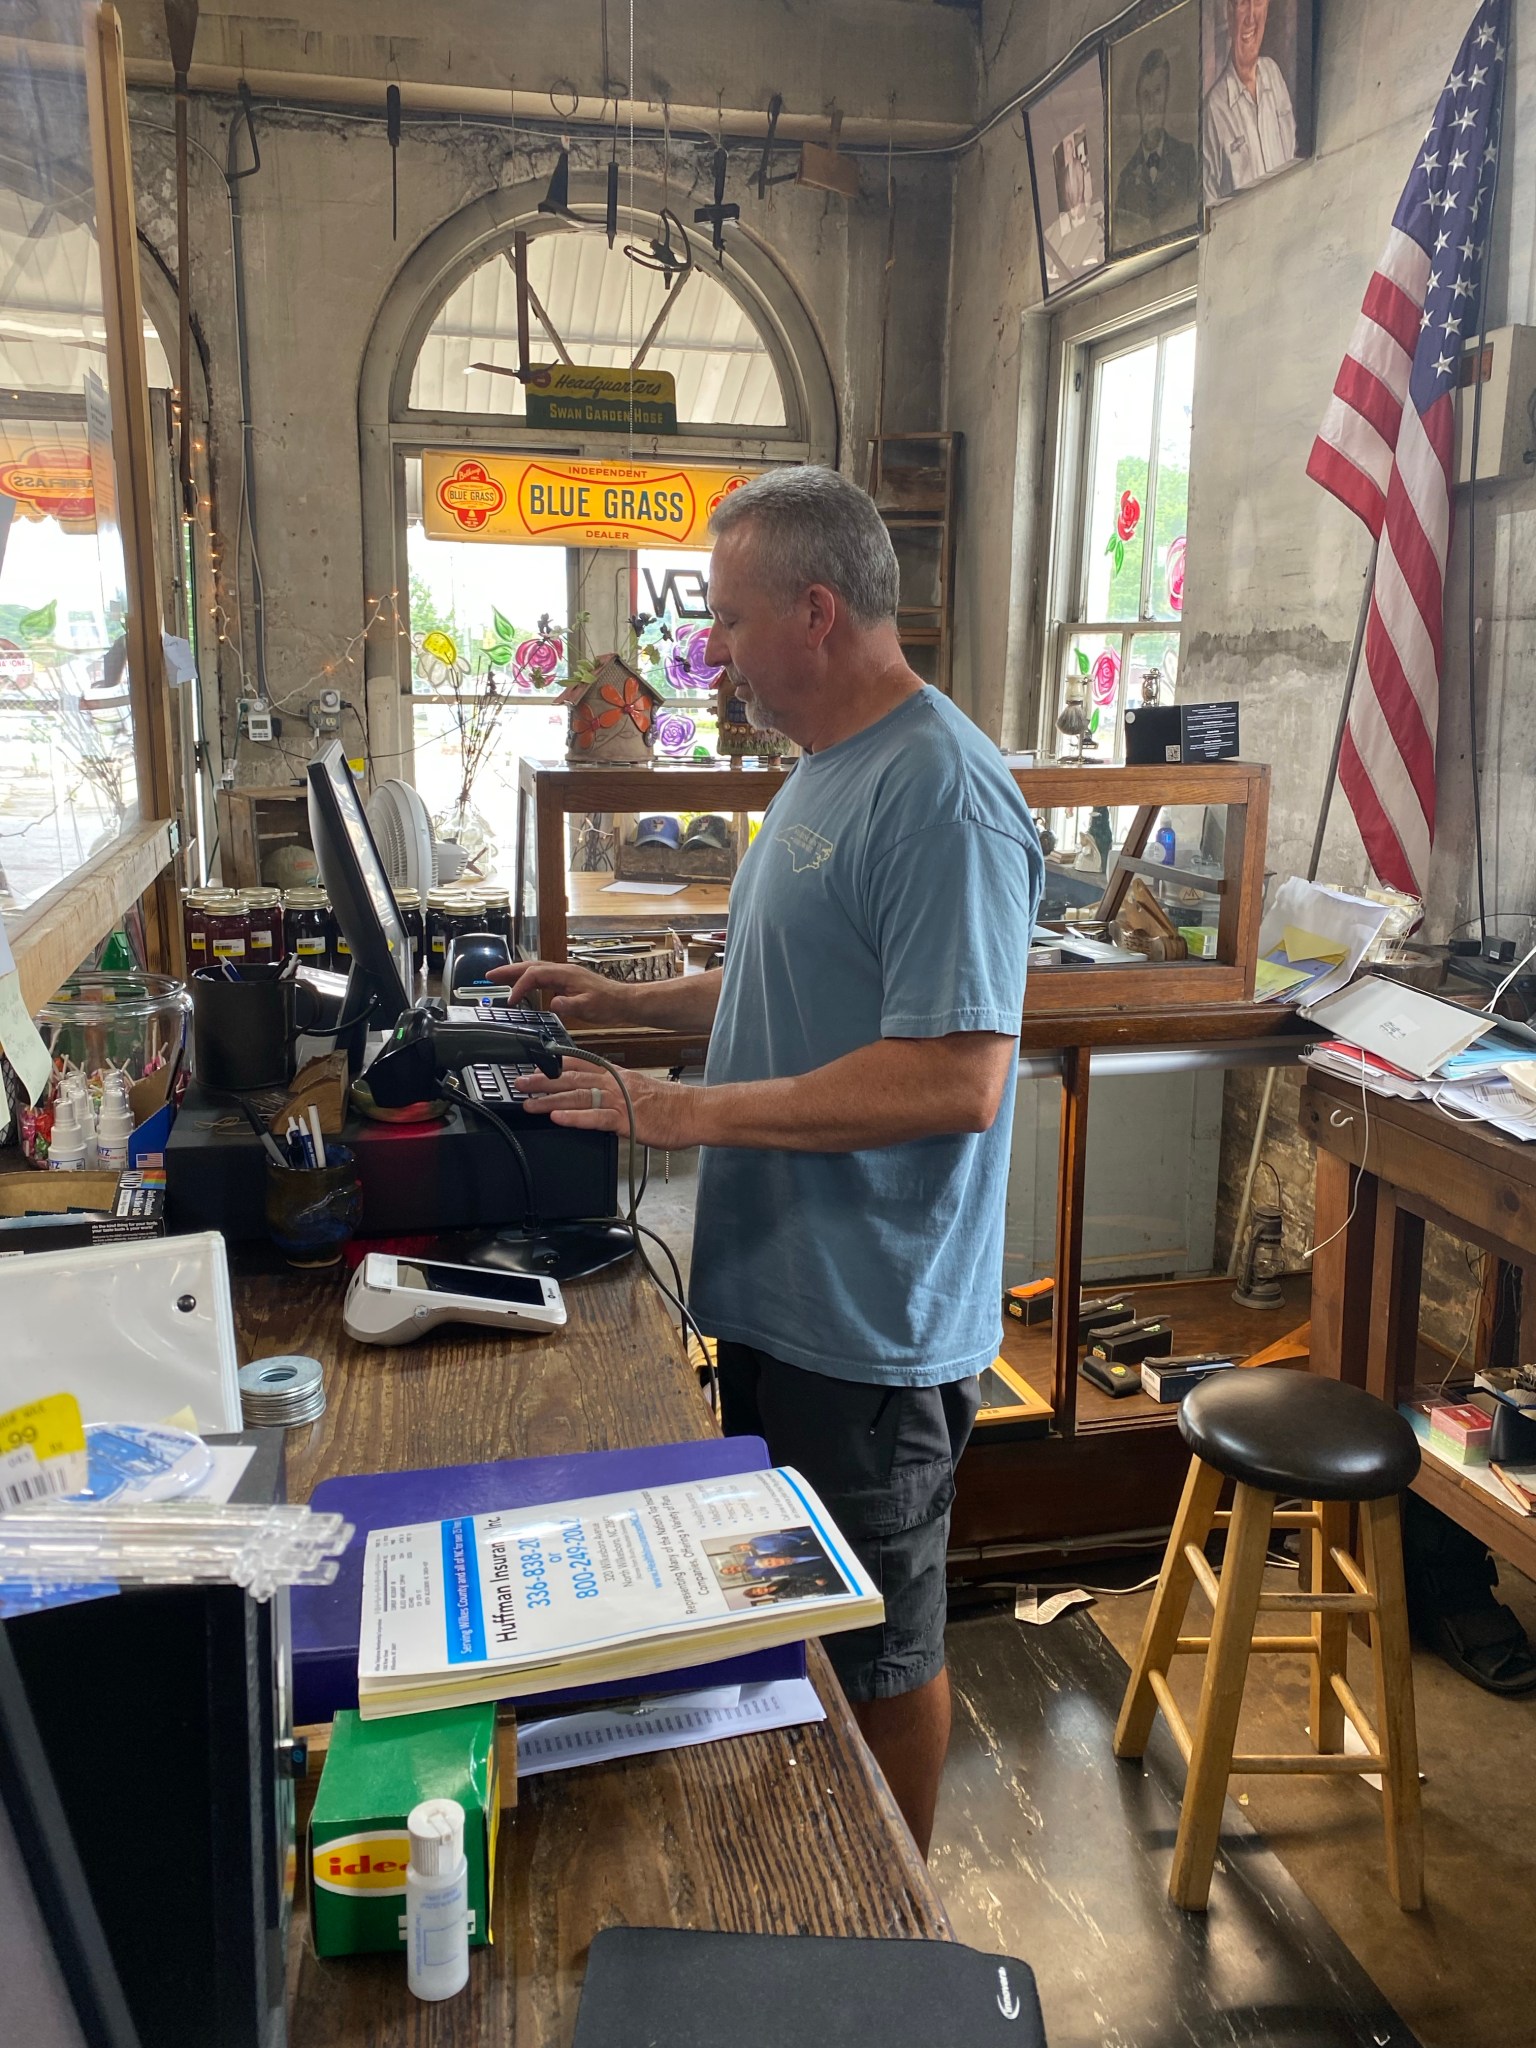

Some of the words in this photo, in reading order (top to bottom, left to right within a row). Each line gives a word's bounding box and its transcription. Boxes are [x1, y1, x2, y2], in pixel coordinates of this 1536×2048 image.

[554, 374, 662, 398] Headquarters
[550, 403, 582, 419] SWAN
[585, 405, 631, 422] GARDEN
[634, 408, 663, 424] HOSE
[569, 466, 647, 478] INDEPENDENT
[449, 490, 467, 500] BLUE
[470, 491, 494, 502] GRASS
[530, 484, 591, 517] BLUE
[604, 488, 684, 522] GRASS
[586, 530, 629, 540] DEALER
[120, 1170, 144, 1188] KIND
[669, 1511, 682, 1530] Variety
[660, 1536, 671, 1546] the
[678, 1533, 694, 1557] Offering
[454, 1556, 465, 1564] of
[489, 1541, 510, 1582] Insuran
[548, 1553, 562, 1563] or
[668, 1554, 680, 1572] Many
[454, 1564, 466, 1573] all
[455, 1572, 466, 1584] and
[517, 1537, 551, 1609] 336-838-20
[603, 1570, 615, 1582] 320
[619, 1569, 632, 1587] North
[689, 1559, 710, 1596] Companies,
[457, 1584, 469, 1608] County
[675, 1571, 697, 1615] Representing
[458, 1608, 470, 1629] Wilkes
[492, 1585, 518, 1643] Huffman
[460, 1629, 473, 1655] Serving
